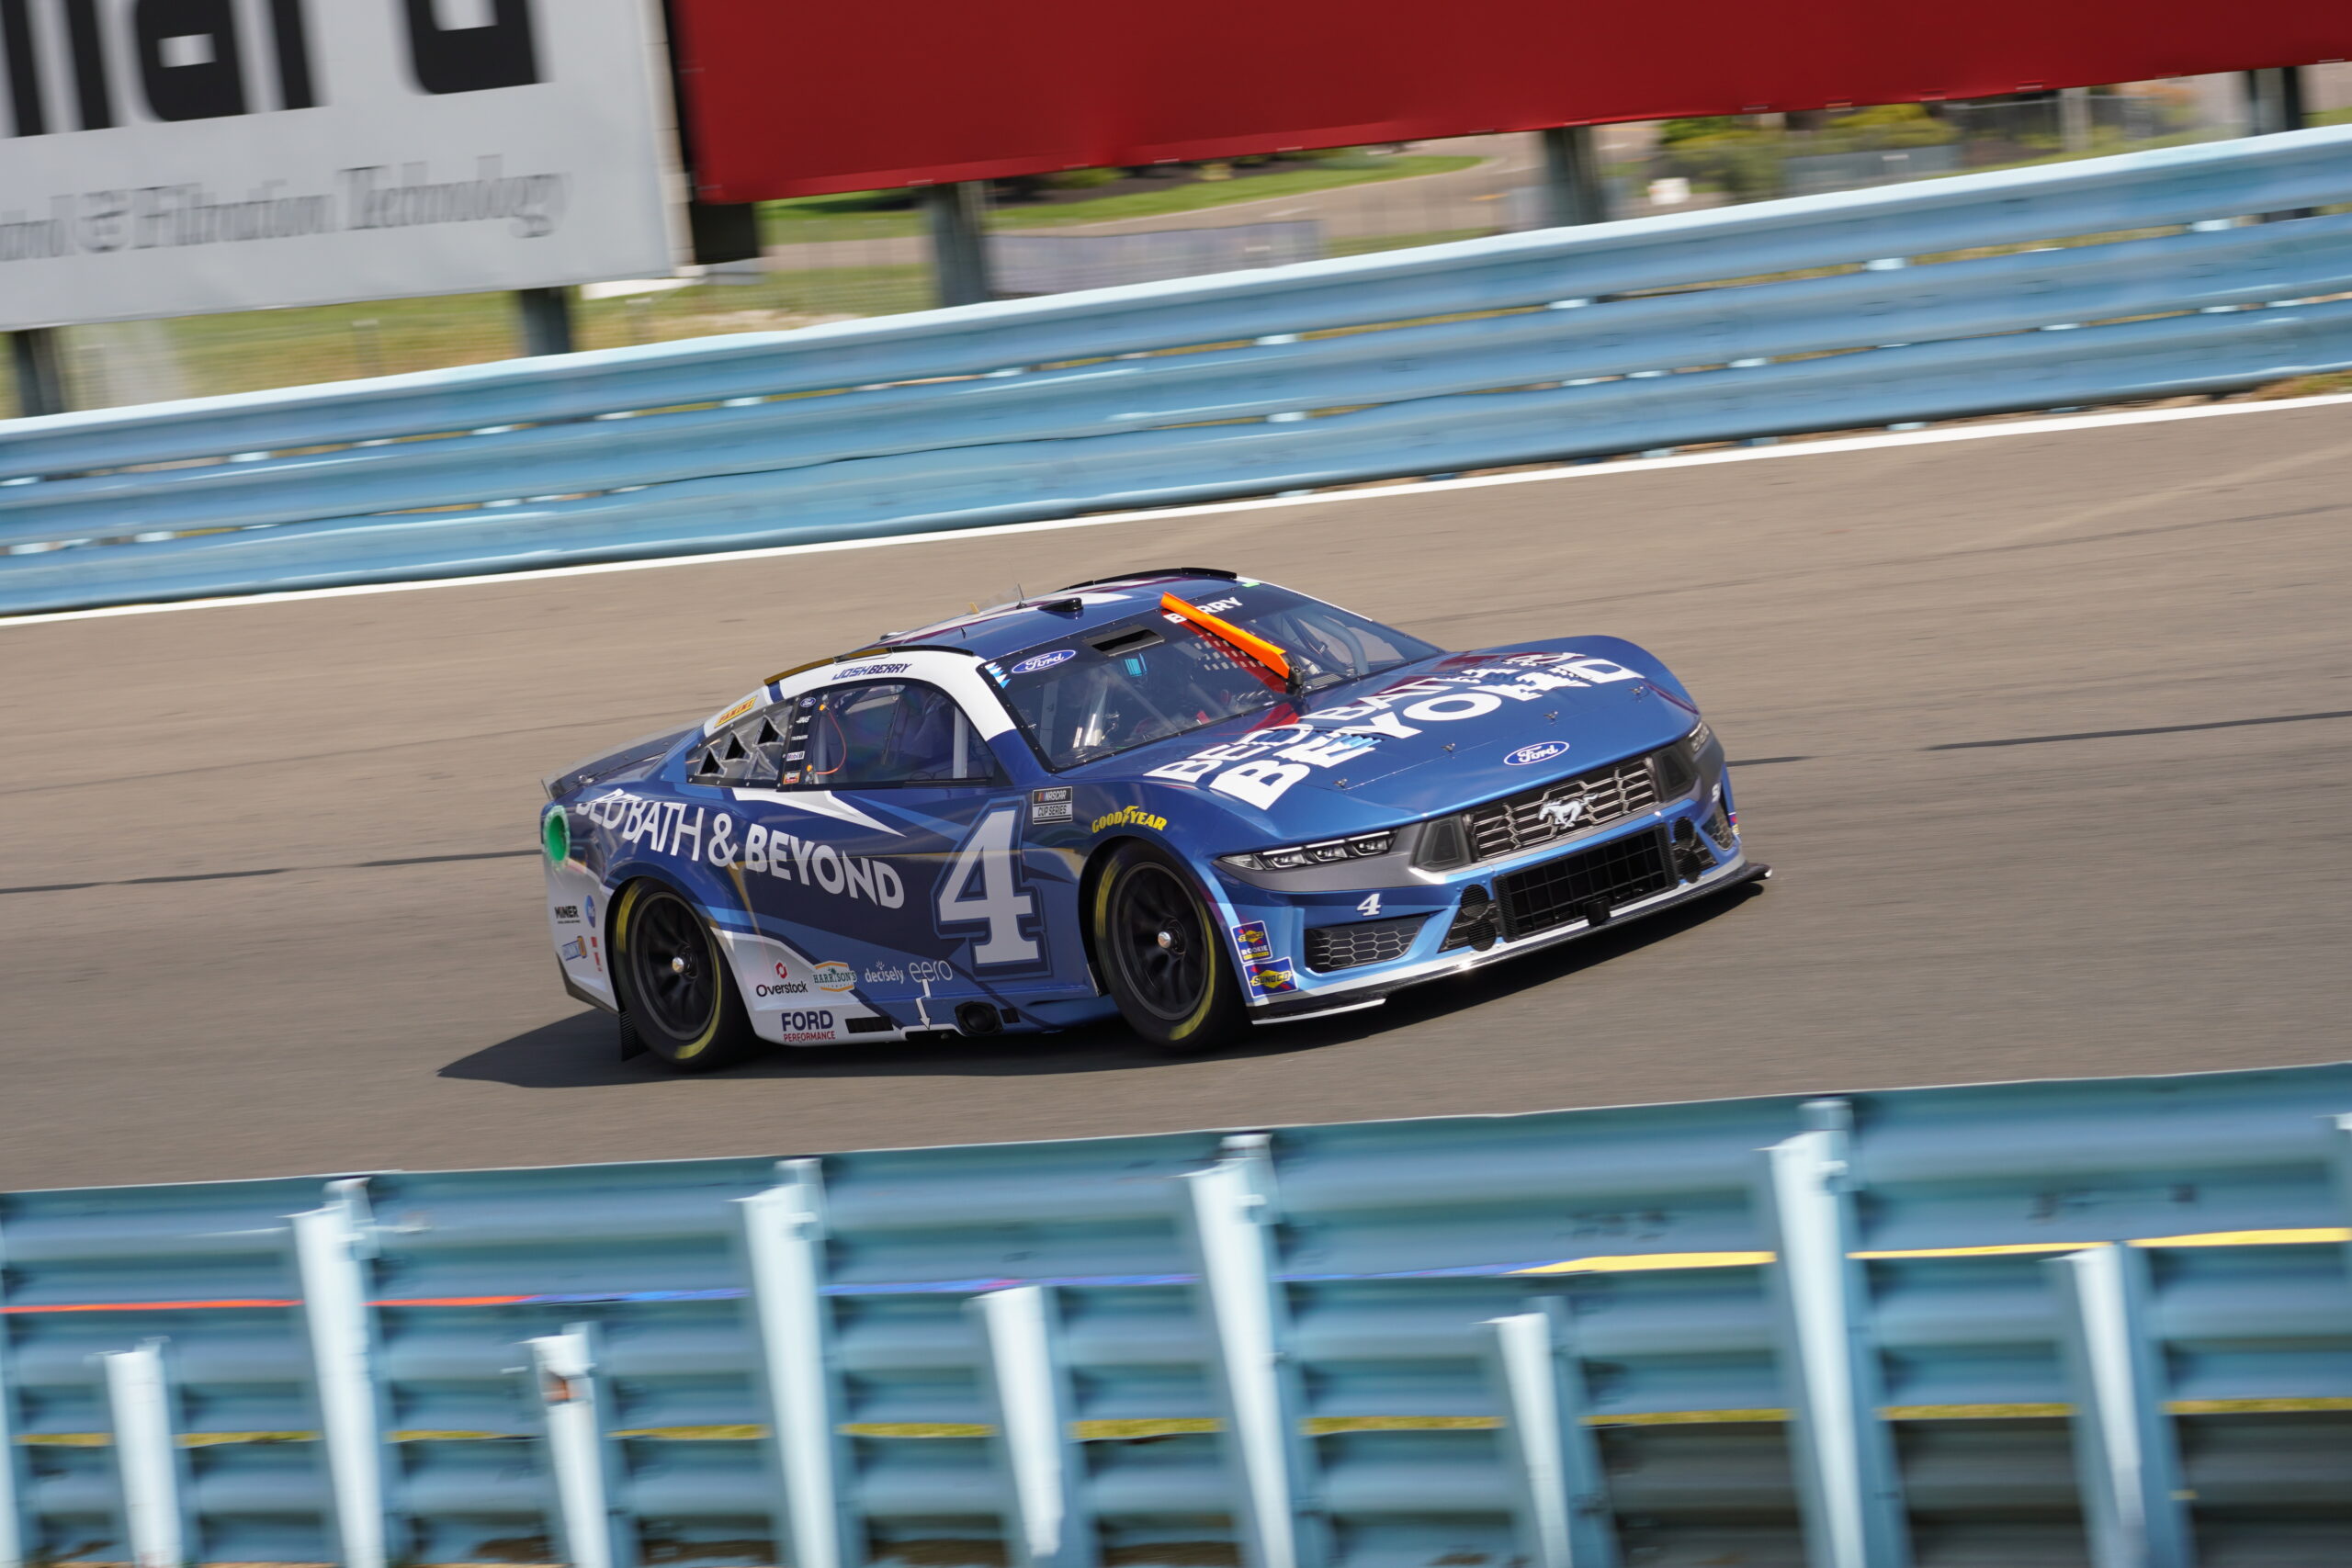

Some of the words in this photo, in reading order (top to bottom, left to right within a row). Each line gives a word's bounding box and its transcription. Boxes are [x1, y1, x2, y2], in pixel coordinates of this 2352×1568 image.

[334, 154, 571, 239] Technology
[1163, 597, 1242, 625] BRRY
[1209, 659, 1645, 811] BEYOND
[1143, 723, 1314, 784] BED
[1044, 790, 1067, 801] NASCAR
[1037, 807, 1048, 817] CUP
[1048, 805, 1067, 816] SERIES
[622, 800, 705, 862] BATH
[707, 812, 739, 871] &
[744, 823, 905, 909] BEYOND
[939, 809, 1039, 964] 4
[555, 906, 579, 919] MINER
[1356, 893, 1382, 917] 4
[1241, 945, 1268, 955] ROOKIE
[814, 971, 857, 984] HARRISON'S
[865, 968, 904, 984] decisely
[909, 960, 953, 983] eero
[1253, 971, 1291, 985] SUNOCO
[756, 981, 808, 998] Overstock
[782, 1010, 833, 1032] FORD
[784, 1031, 836, 1043] PERFORMANCE
